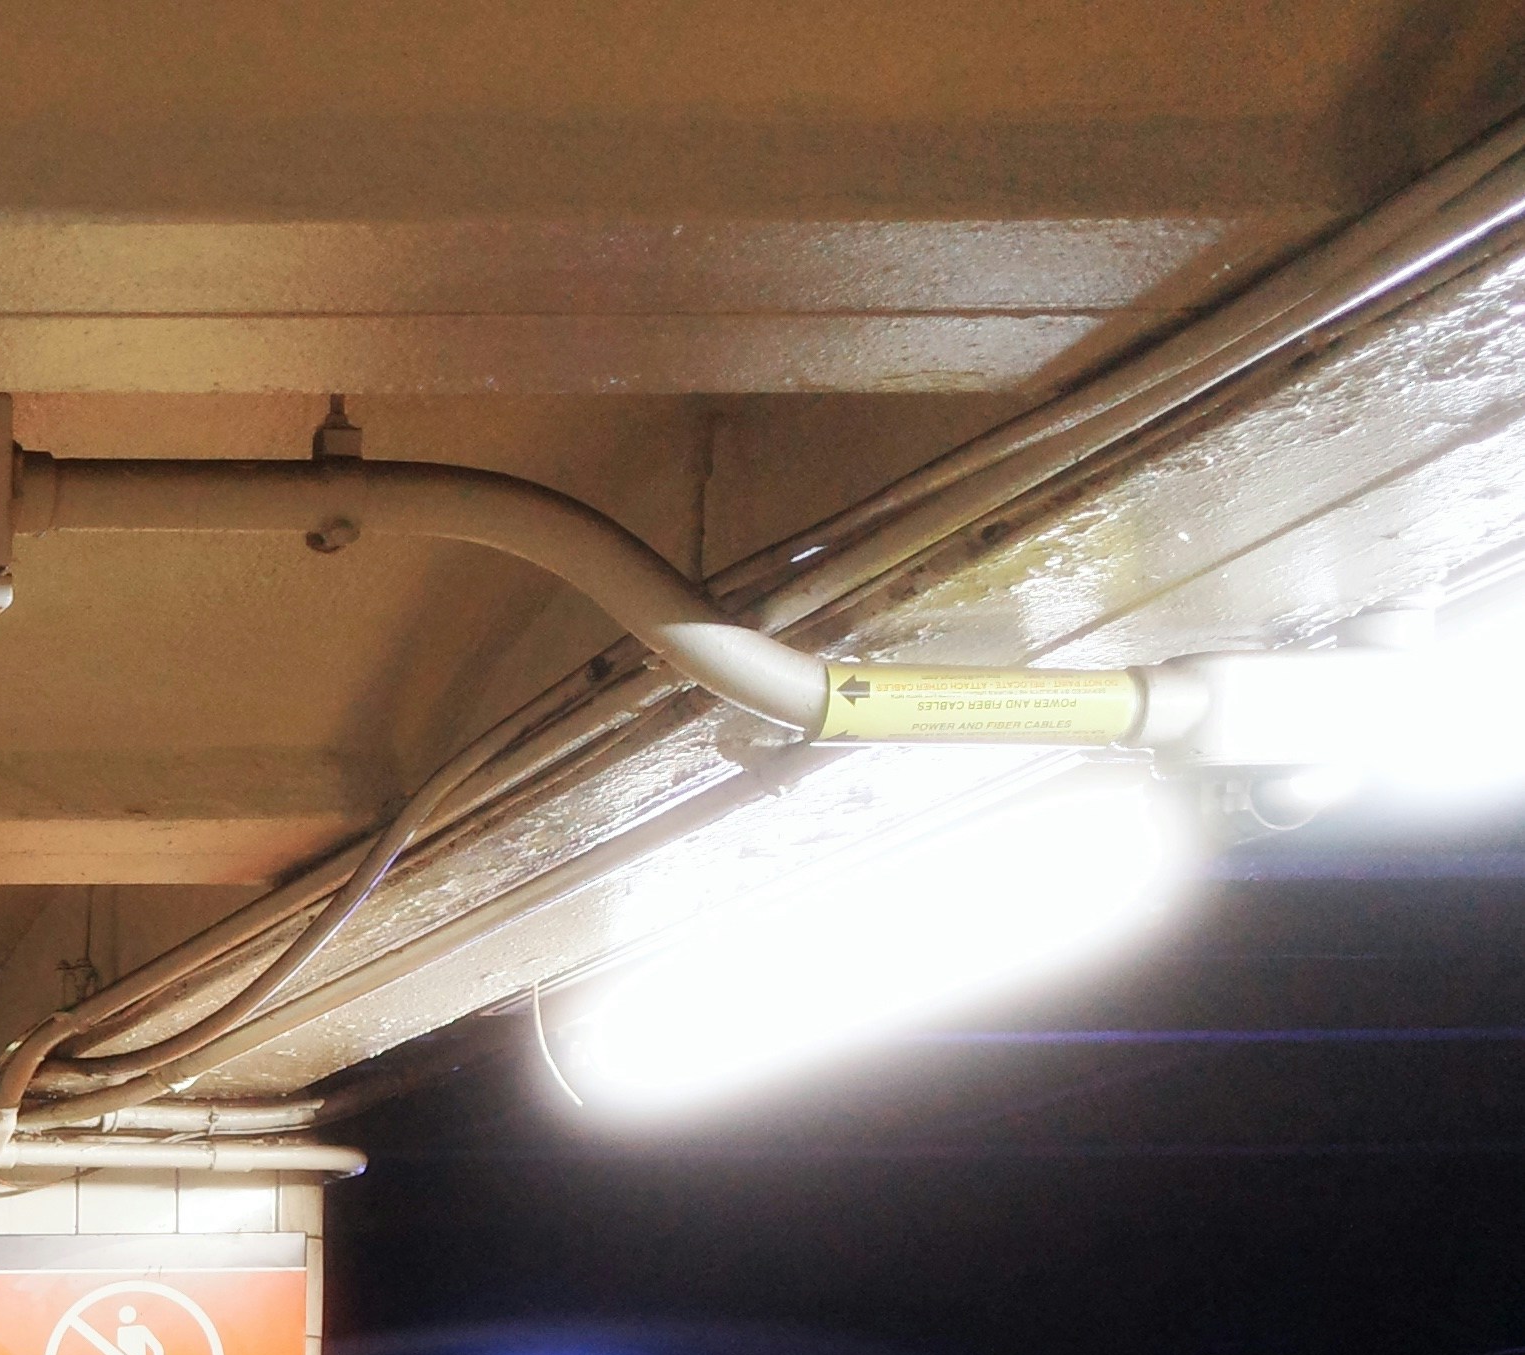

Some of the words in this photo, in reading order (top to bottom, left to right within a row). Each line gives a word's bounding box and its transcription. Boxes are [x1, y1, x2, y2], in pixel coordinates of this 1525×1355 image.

[917, 701, 965, 711] CABLES
[968, 700, 1003, 710] FIBER
[1005, 699, 1031, 709] AND
[1033, 698, 1077, 709] POWER
[911, 722, 955, 731] POWER
[958, 721, 984, 730] AND
[986, 721, 1022, 730] FIBER
[1024, 720, 1072, 729] CABLES
